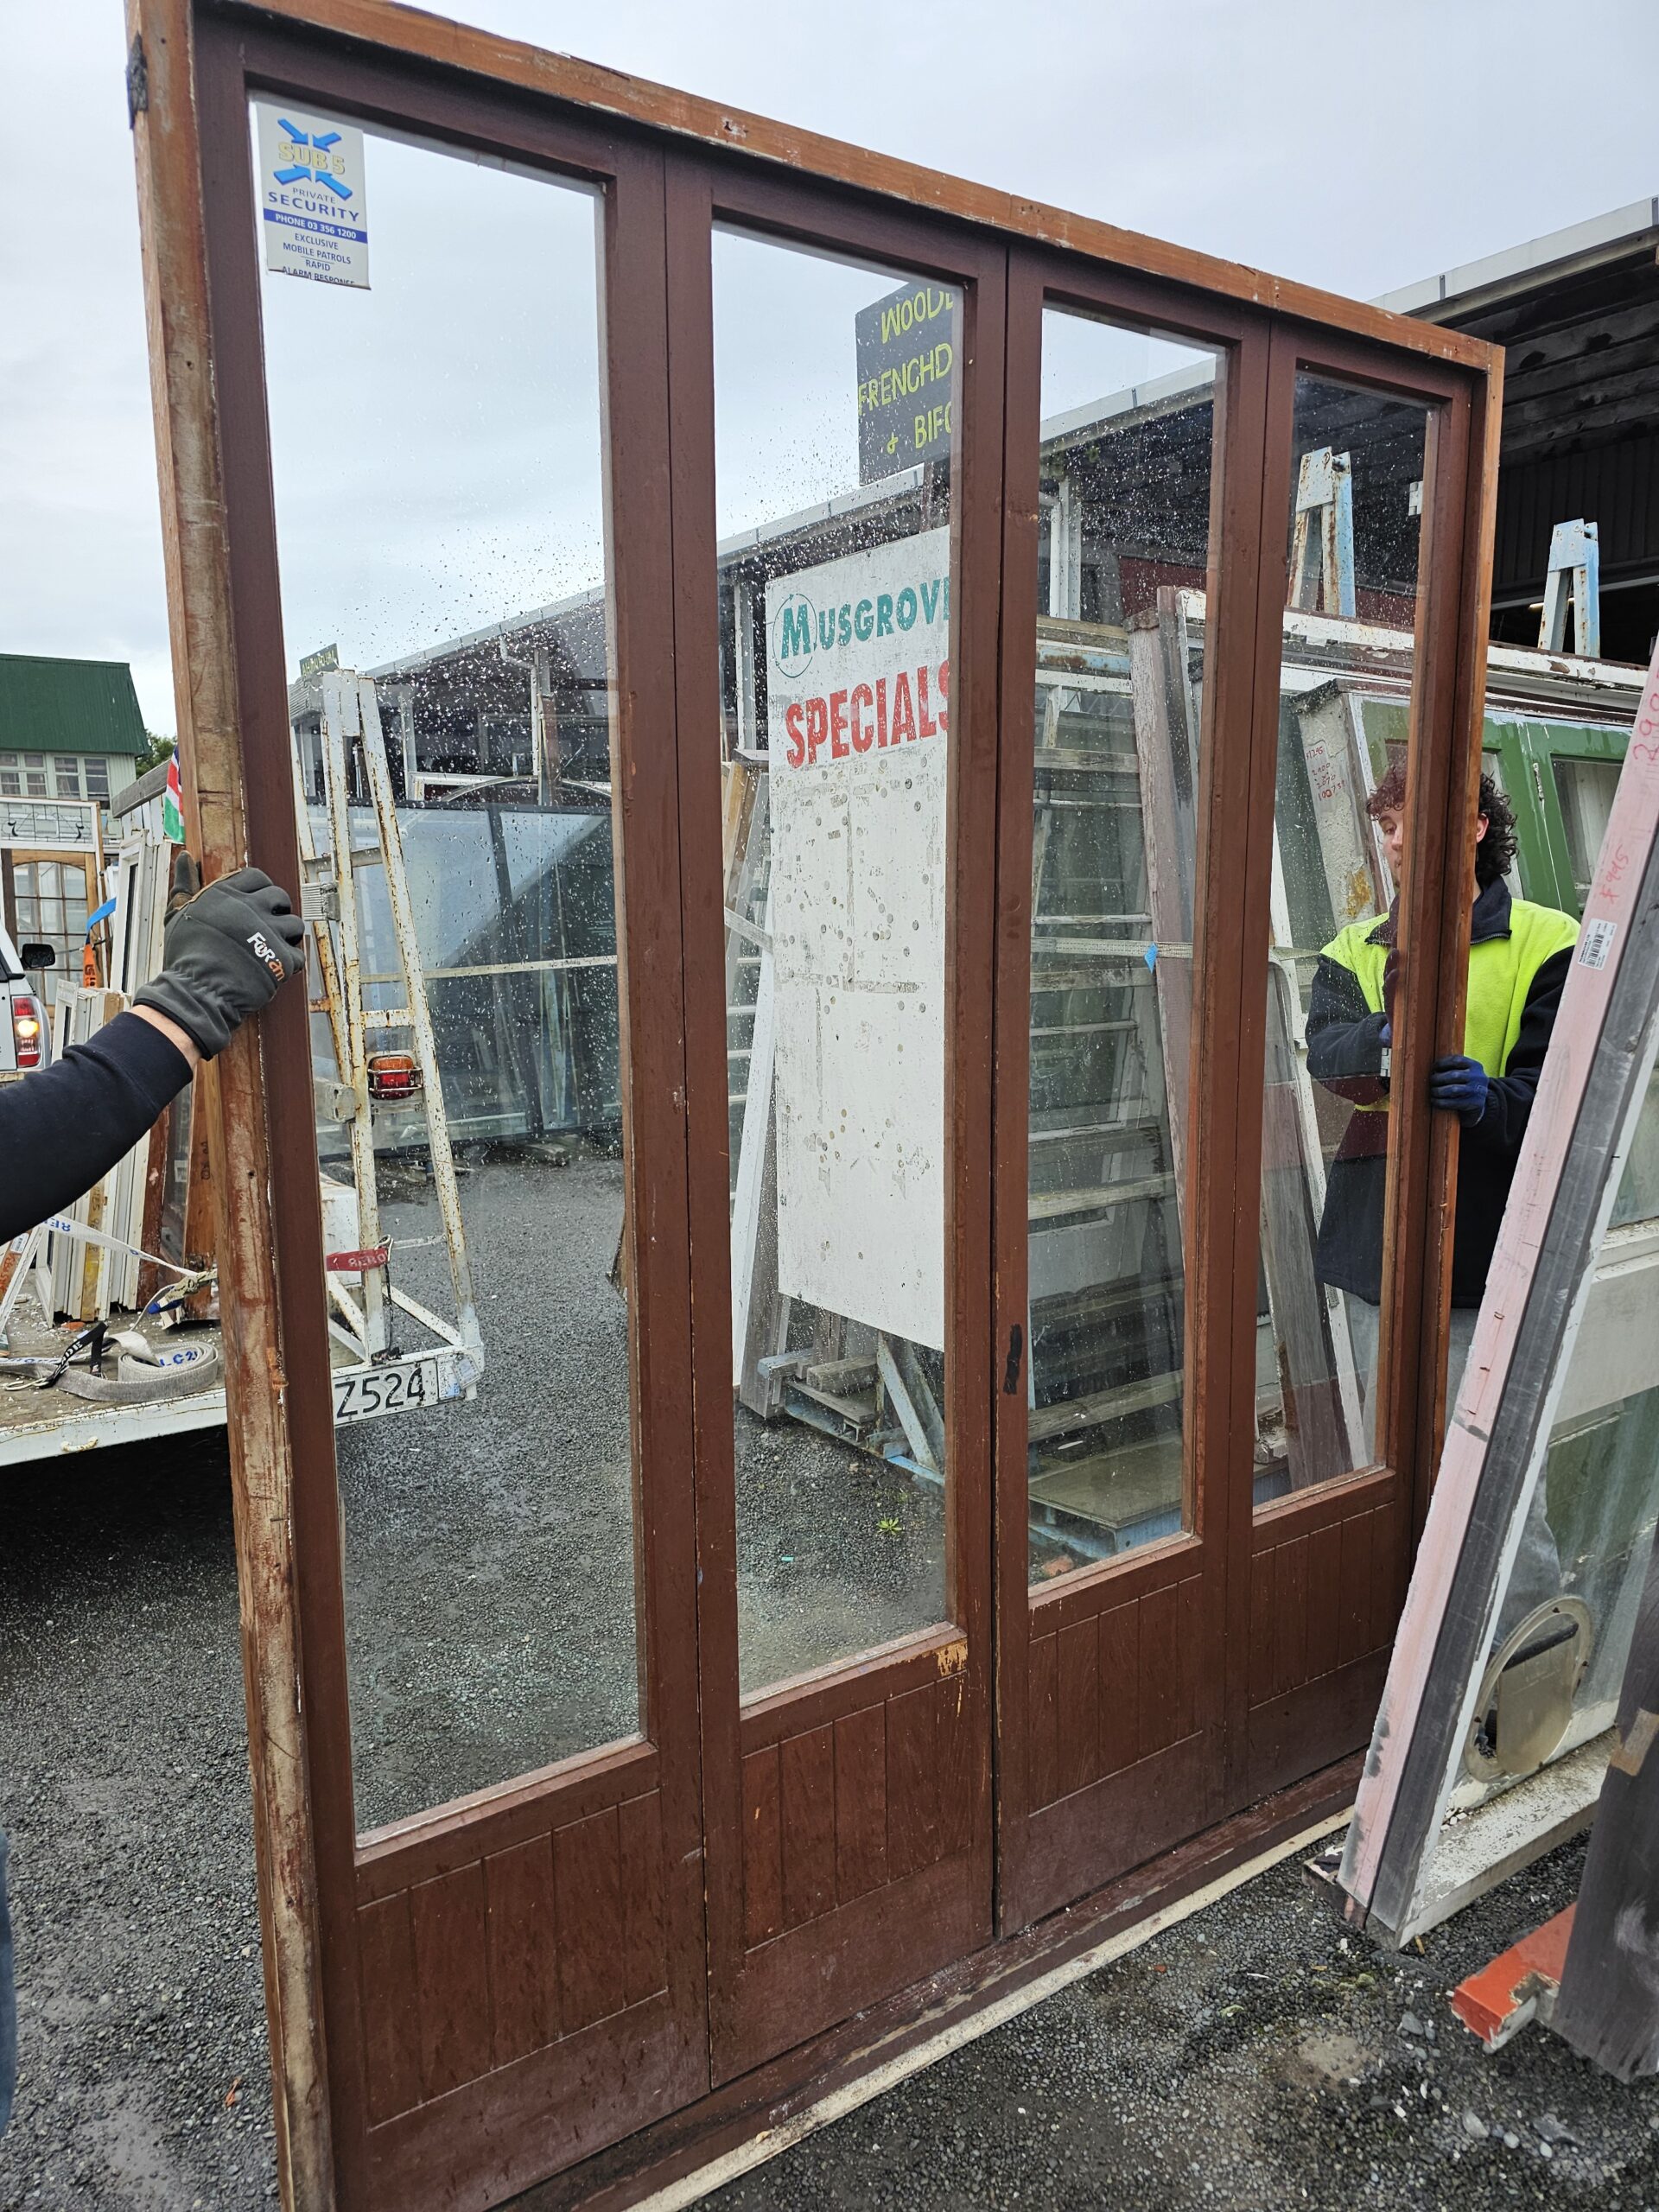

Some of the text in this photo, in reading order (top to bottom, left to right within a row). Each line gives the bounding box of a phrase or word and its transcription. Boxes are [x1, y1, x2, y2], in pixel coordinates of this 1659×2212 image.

[293, 188, 336, 204] PRIVATE
[268, 192, 359, 222] SECURITY
[275, 213, 357, 239] PHONE 03 356 1200
[295, 232, 339, 251] EXCLUSIVE
[283, 242, 352, 264] MOBILE PATROLS
[305, 259, 331, 271] RAPID
